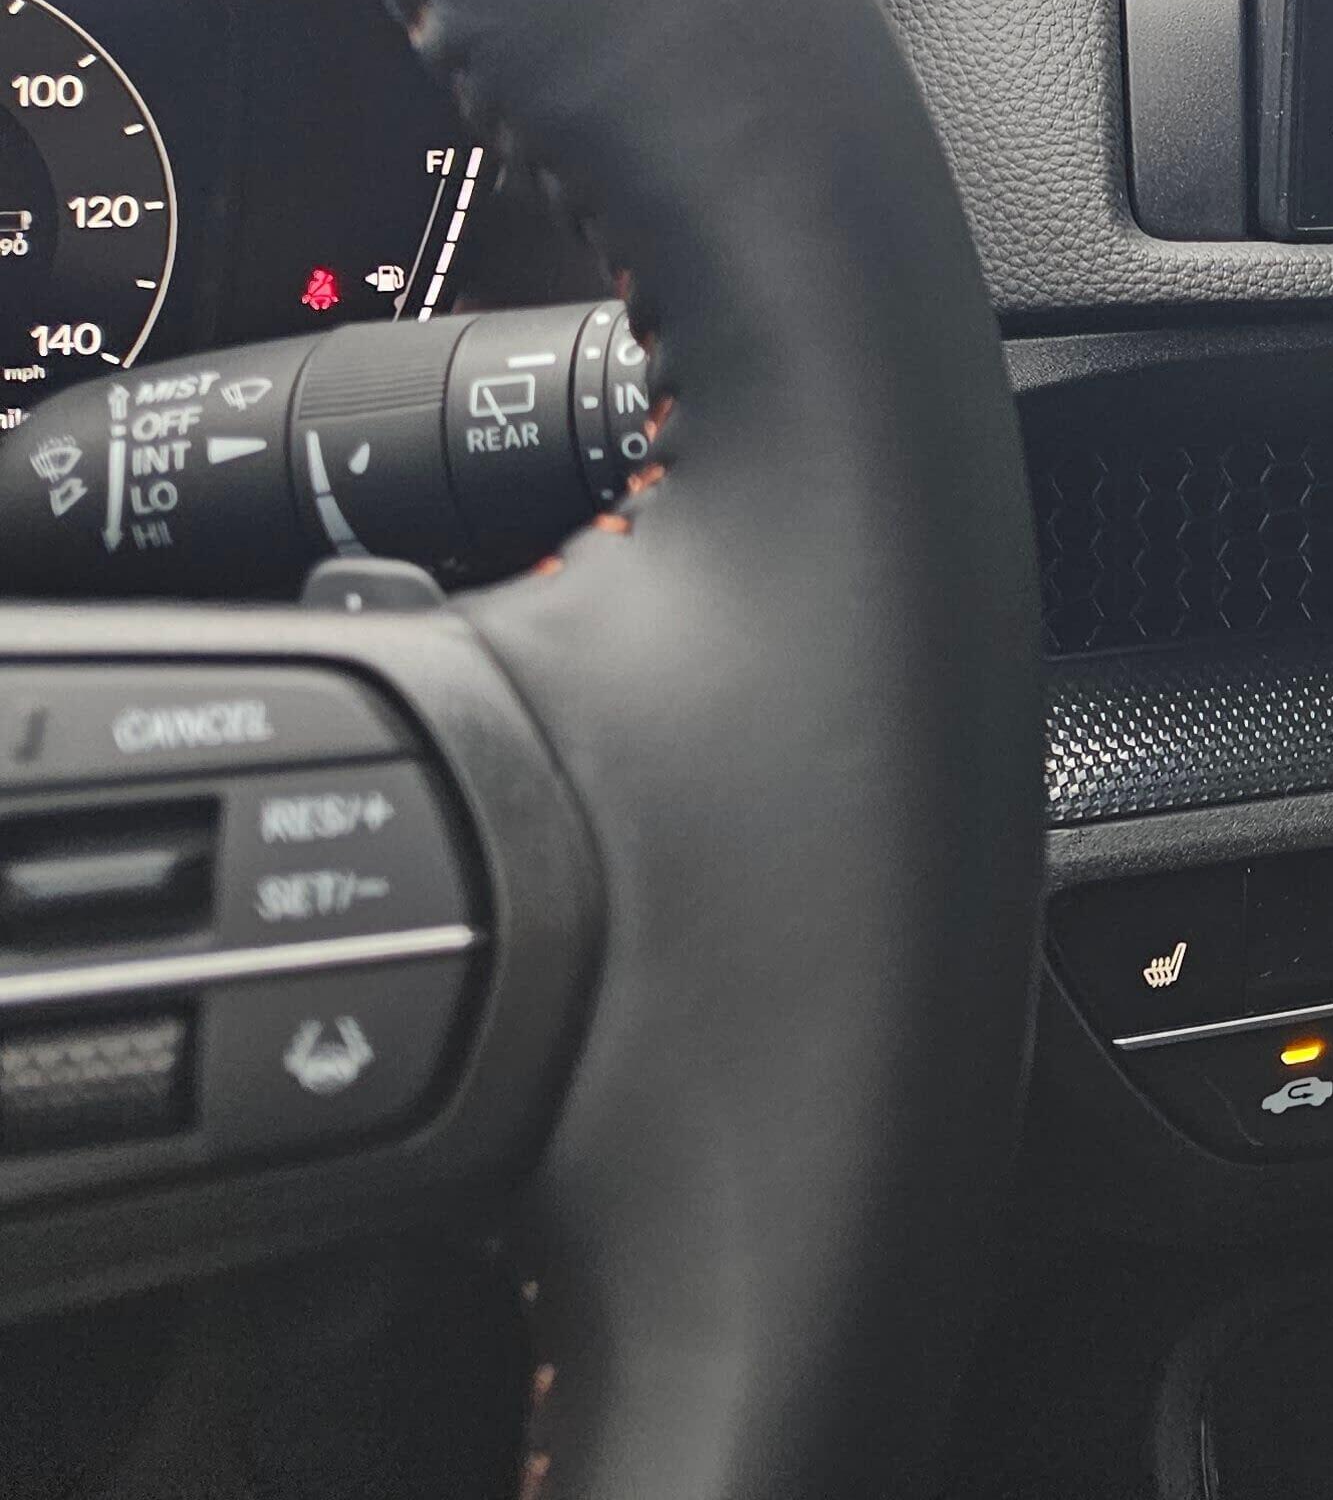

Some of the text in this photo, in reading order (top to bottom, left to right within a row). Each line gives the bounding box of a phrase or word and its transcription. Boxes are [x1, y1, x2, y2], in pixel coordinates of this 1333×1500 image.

[11, 74, 85, 108] 100
[426, 149, 444, 174] F
[67, 194, 140, 229] 120
[30, 322, 103, 357] 140
[4, 364, 46, 383] mph
[135, 371, 221, 406] MIST
[131, 405, 204, 443] OFF
[466, 421, 541, 454] REAR
[132, 440, 192, 477] INT
[130, 480, 178, 515] LO
[130, 520, 173, 549] HI
